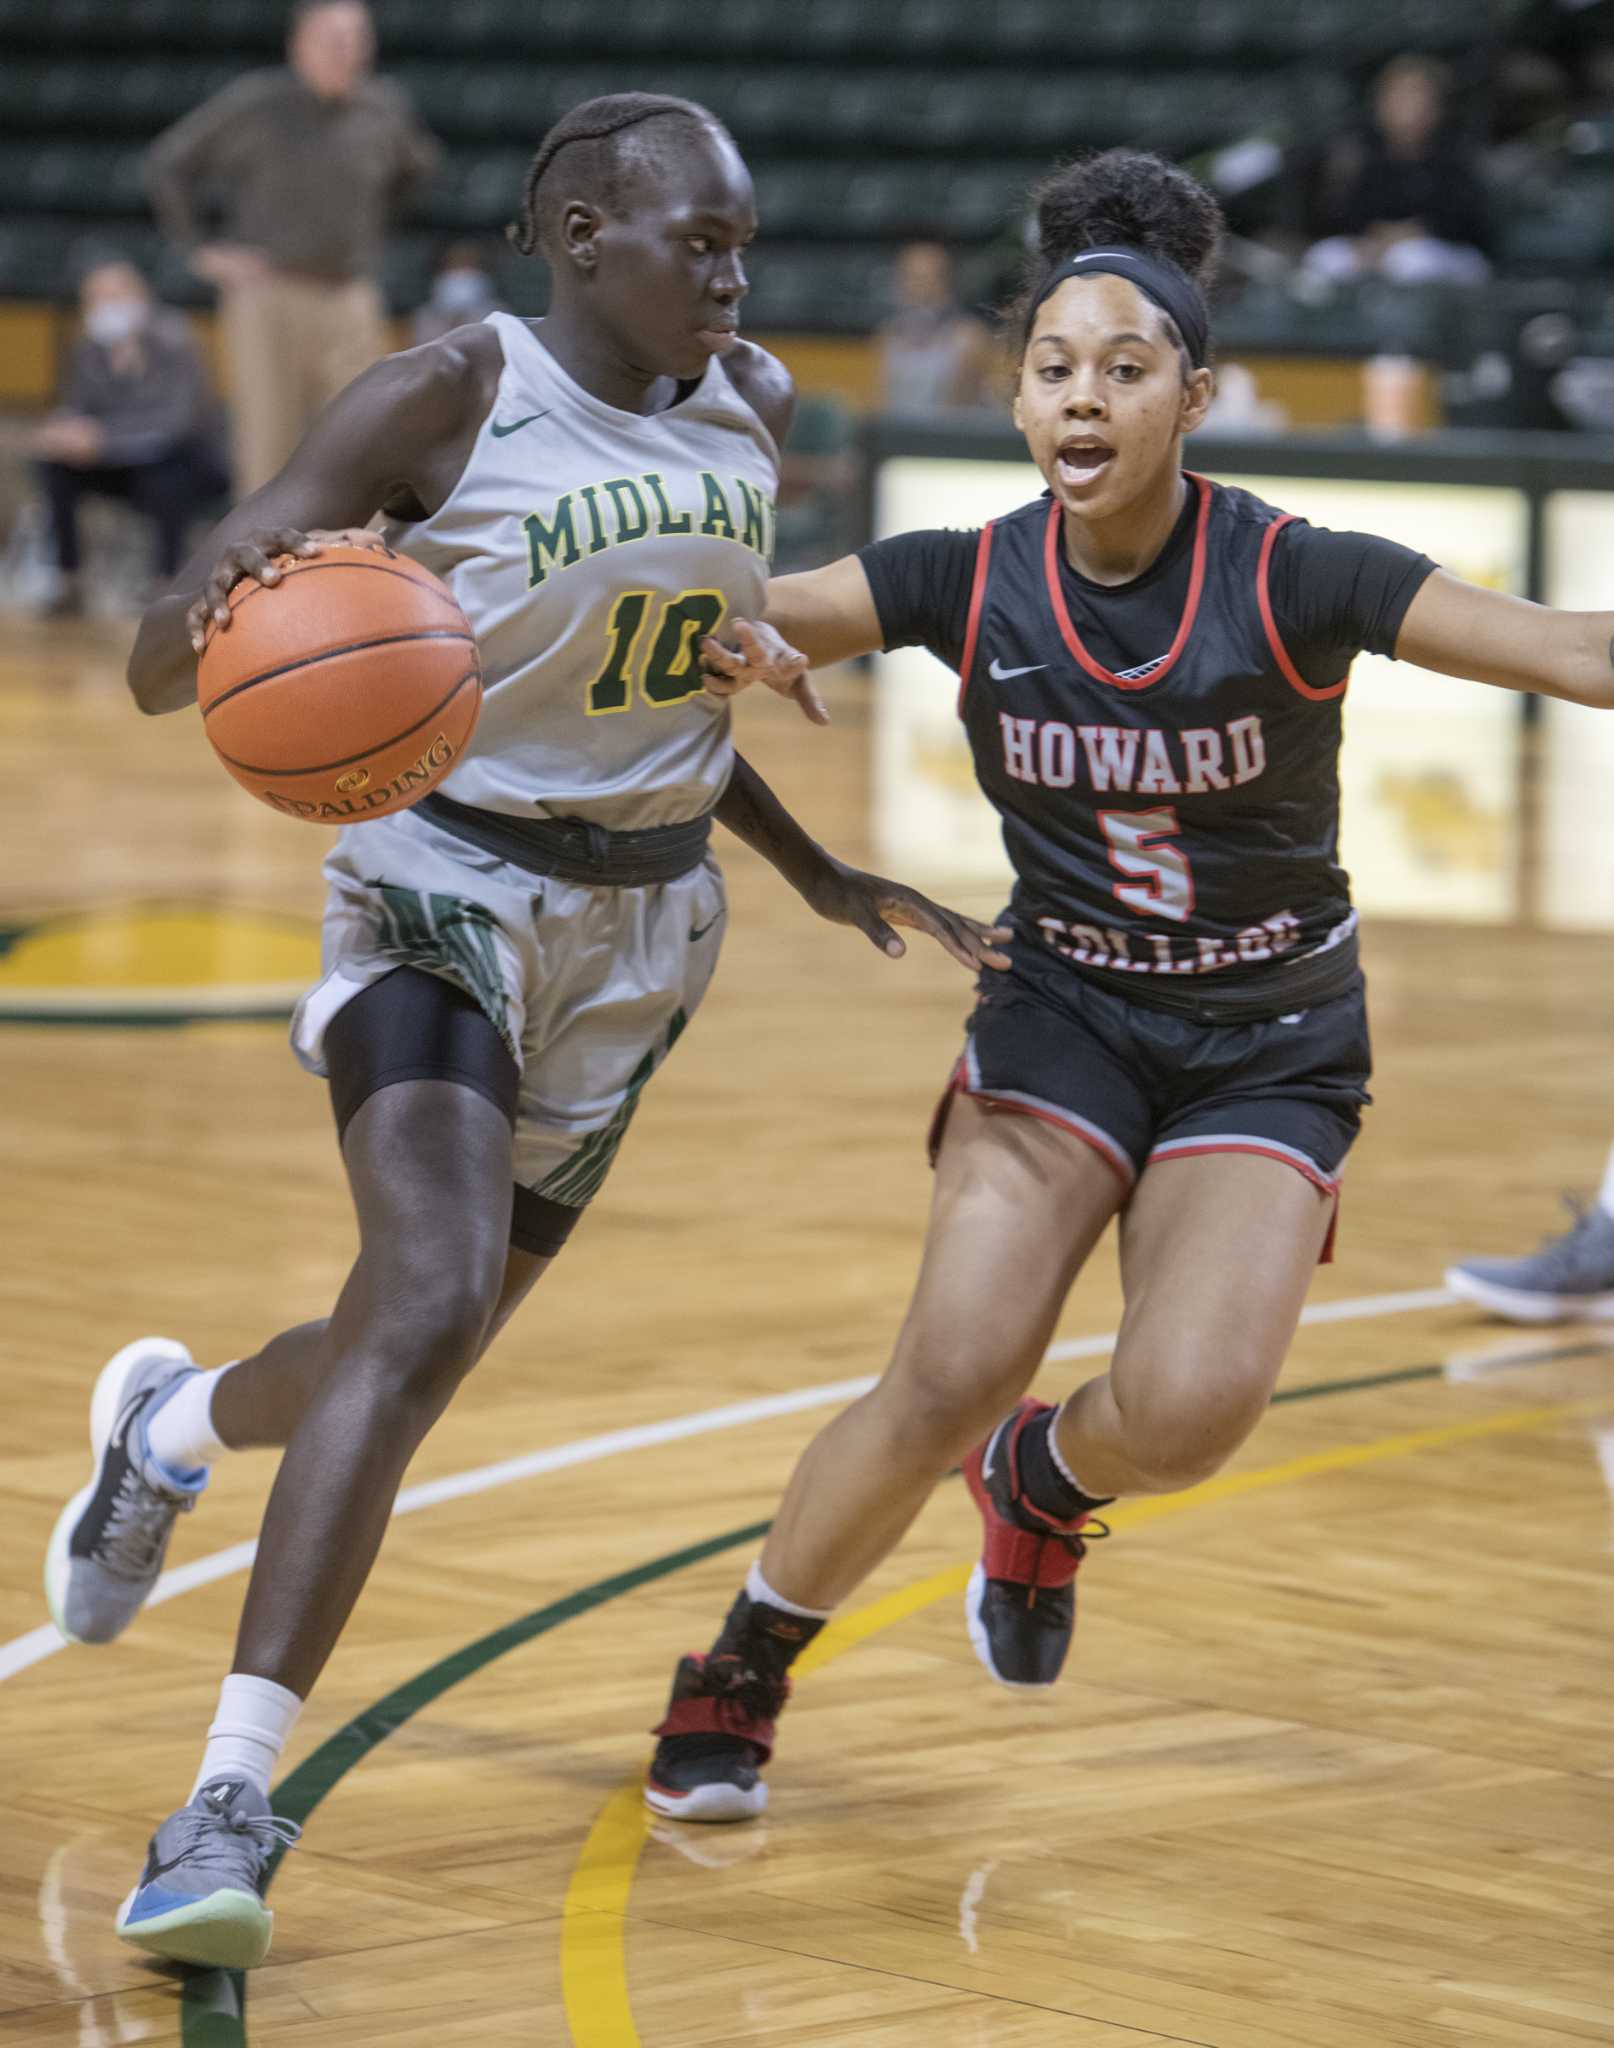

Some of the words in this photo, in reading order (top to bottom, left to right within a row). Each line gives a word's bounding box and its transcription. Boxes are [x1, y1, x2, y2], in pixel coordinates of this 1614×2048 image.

[521, 472, 776, 591] MIDLAN
[585, 589, 728, 716] 10
[1000, 712, 1266, 793] HOWARD
[1097, 807, 1195, 922] 5
